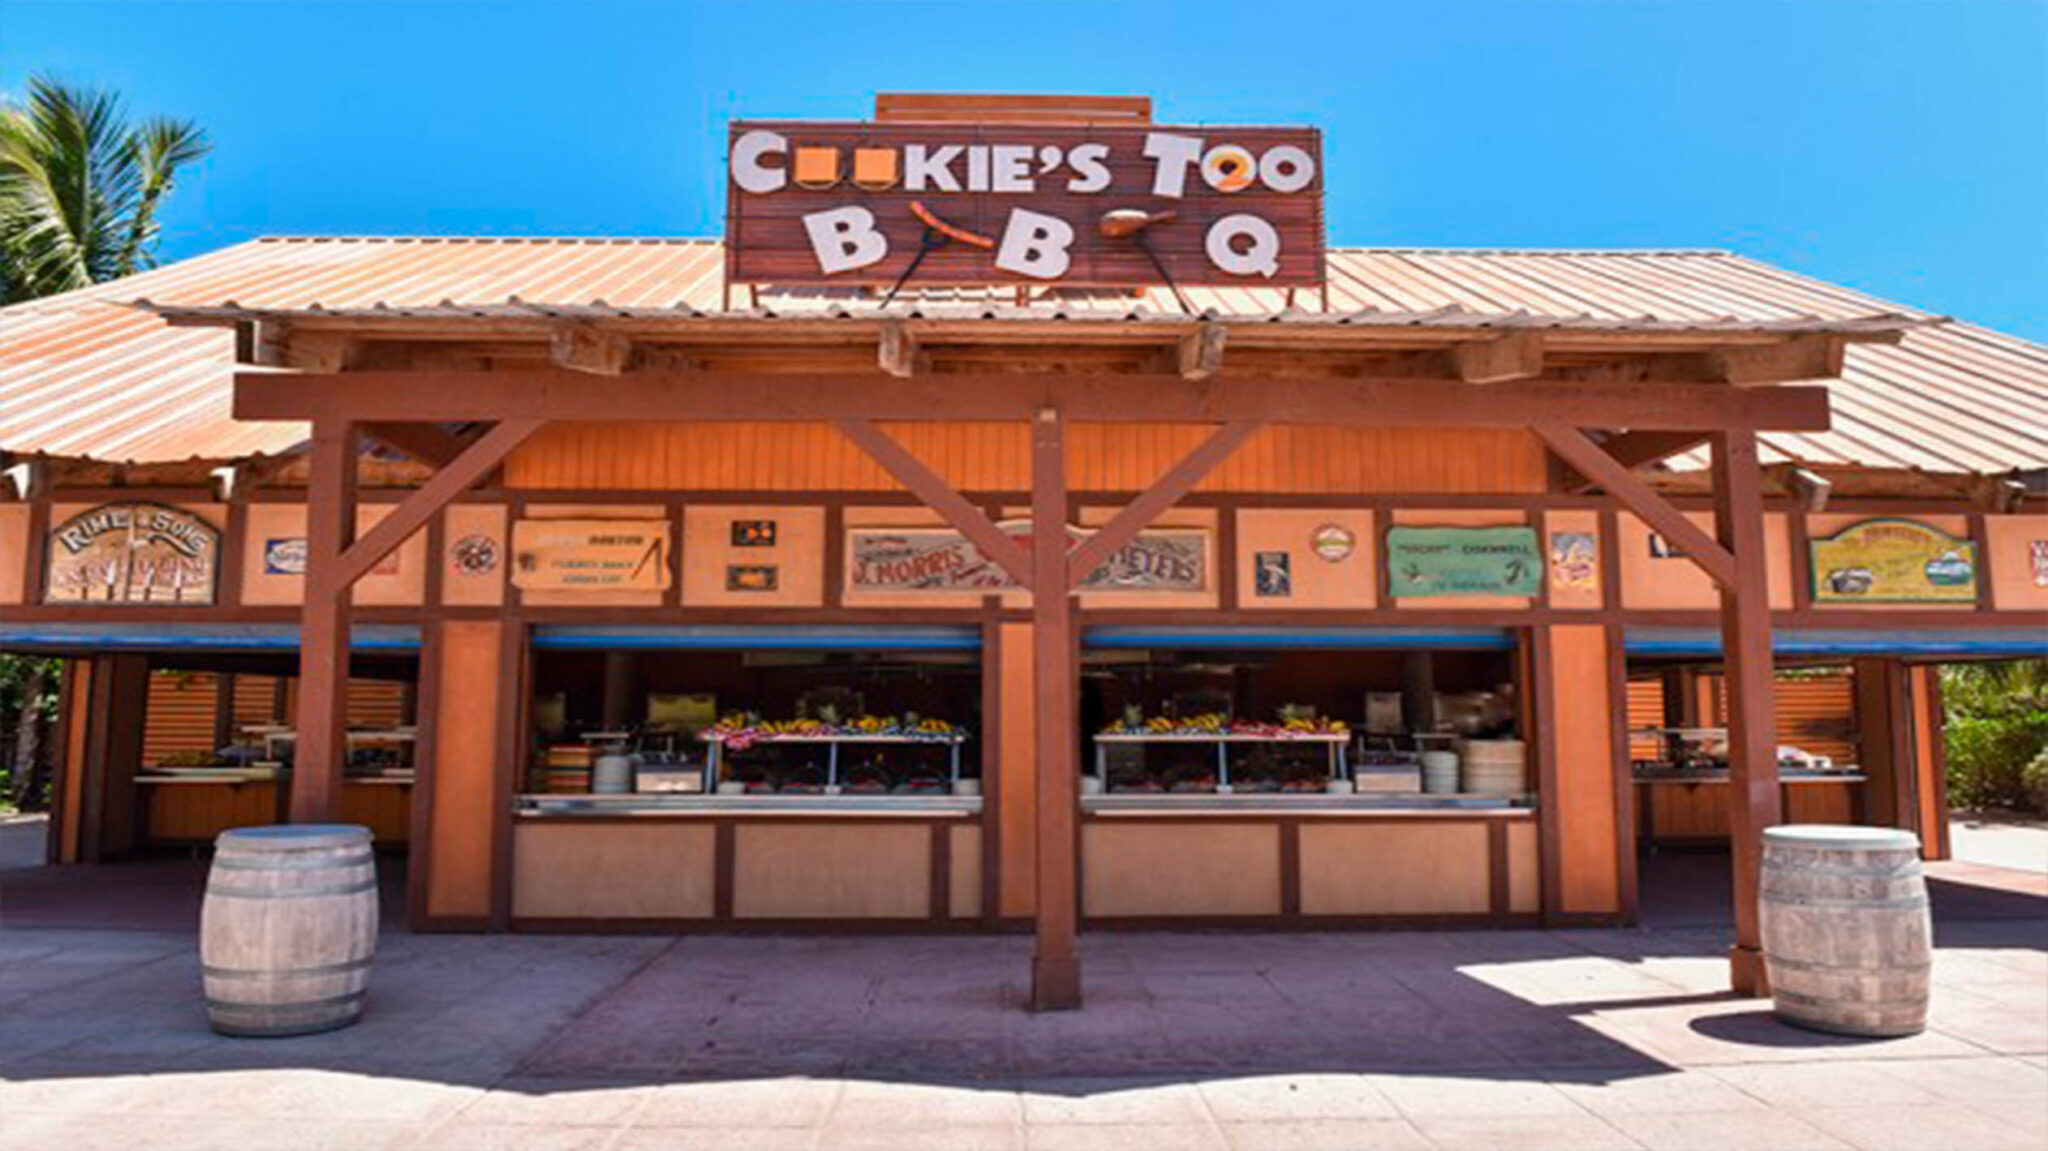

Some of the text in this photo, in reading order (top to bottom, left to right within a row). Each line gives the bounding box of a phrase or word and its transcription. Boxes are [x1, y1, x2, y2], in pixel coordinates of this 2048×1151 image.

[1144, 132, 1315, 198] TOO
[802, 205, 1280, 279] B B Q
